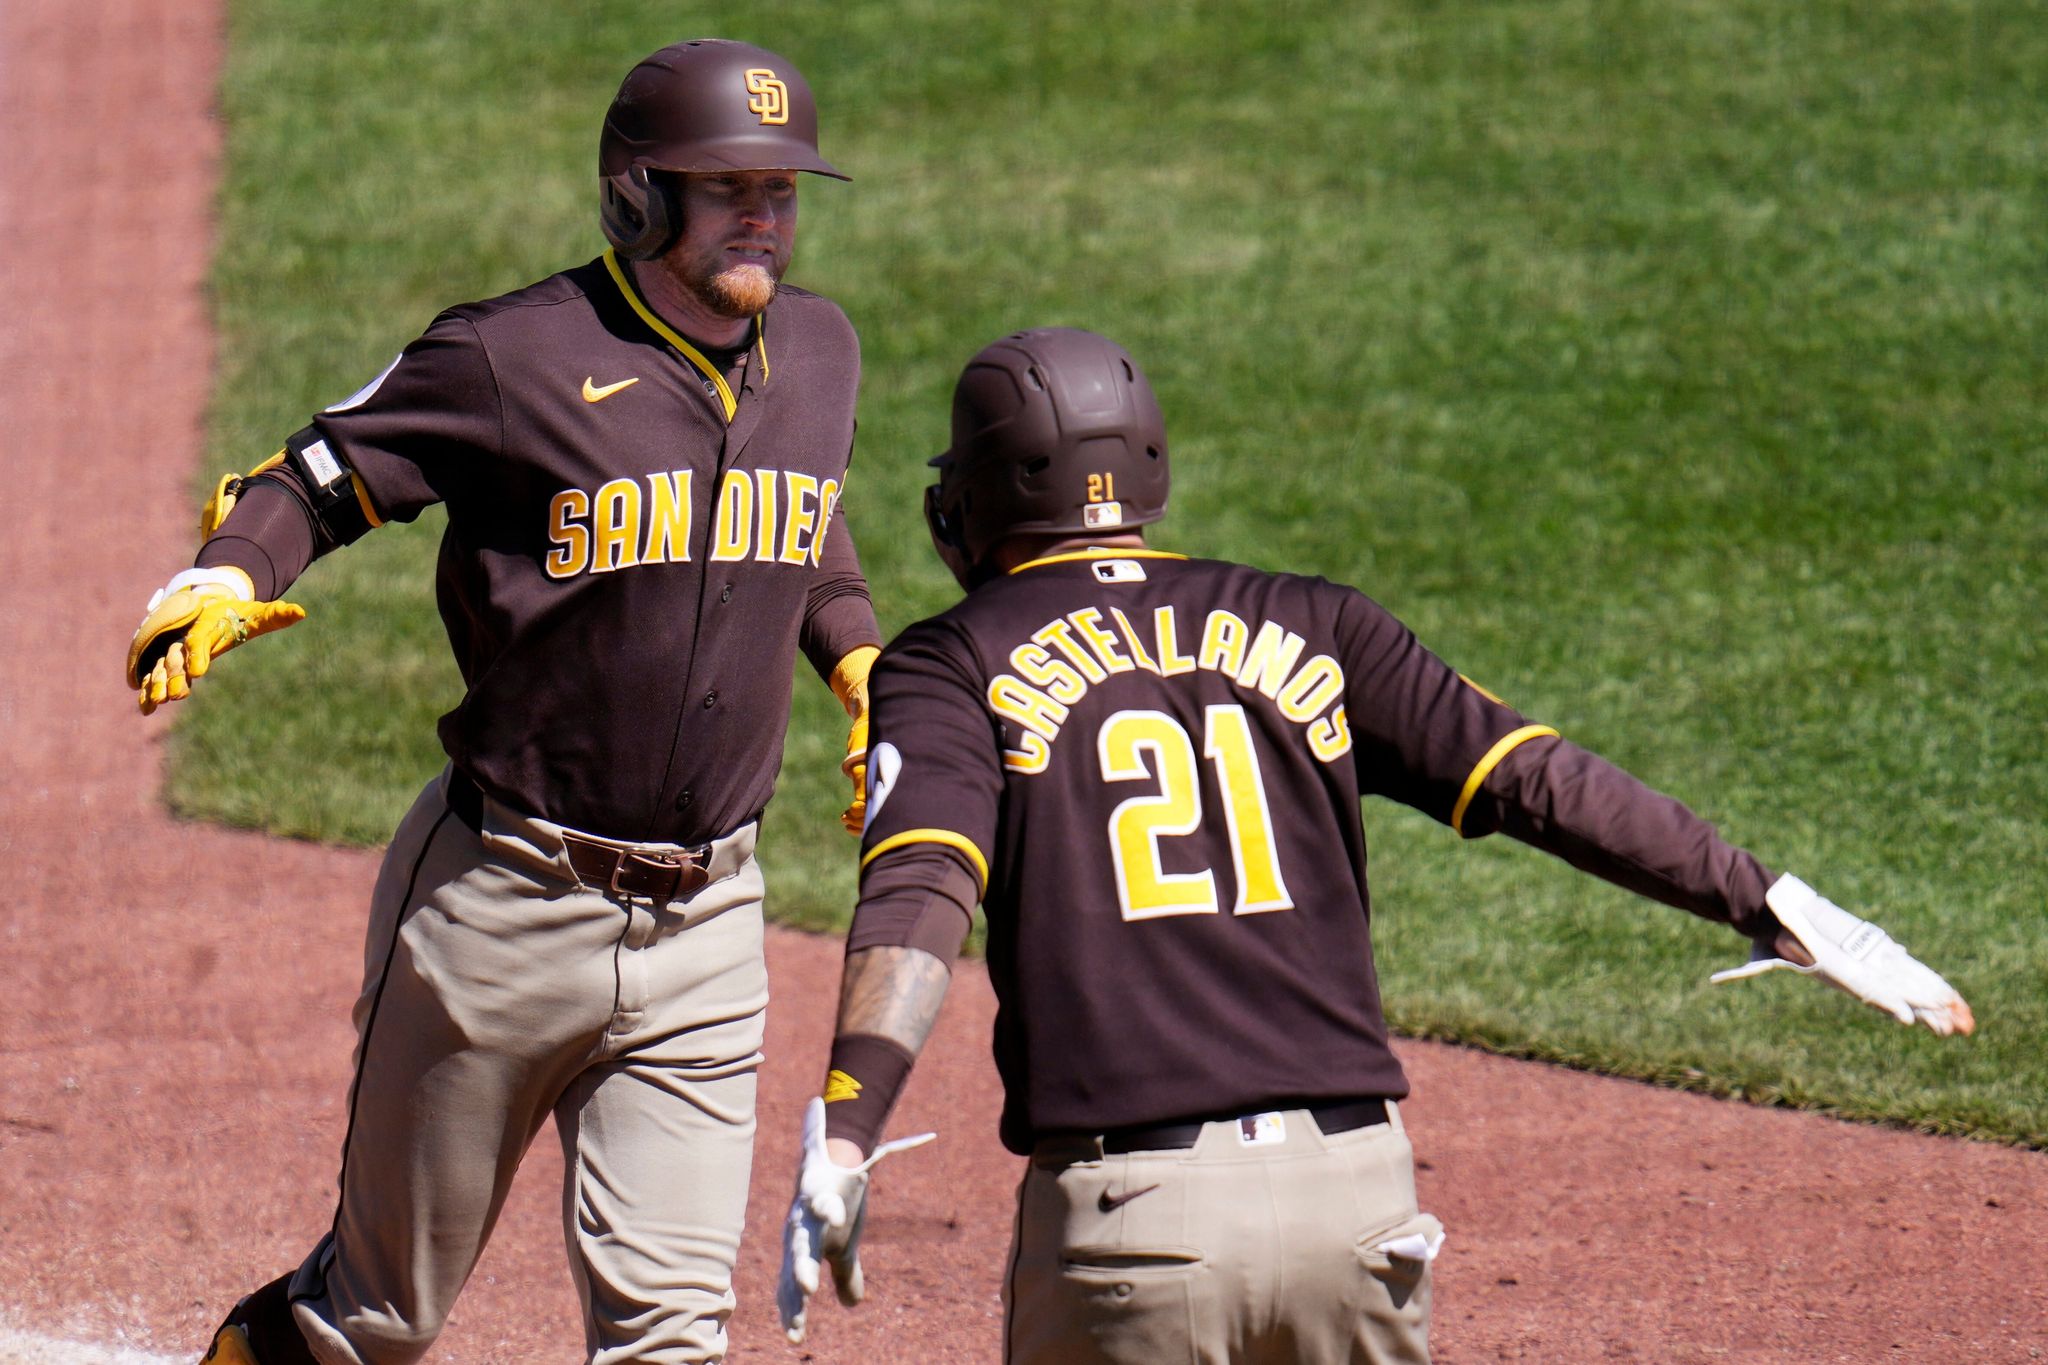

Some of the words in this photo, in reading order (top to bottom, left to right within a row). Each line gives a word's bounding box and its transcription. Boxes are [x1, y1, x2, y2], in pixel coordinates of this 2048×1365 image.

[744, 68, 789, 126] SD
[546, 468, 693, 579] SAN
[1087, 472, 1115, 502] 21
[1096, 704, 1295, 922] 21
